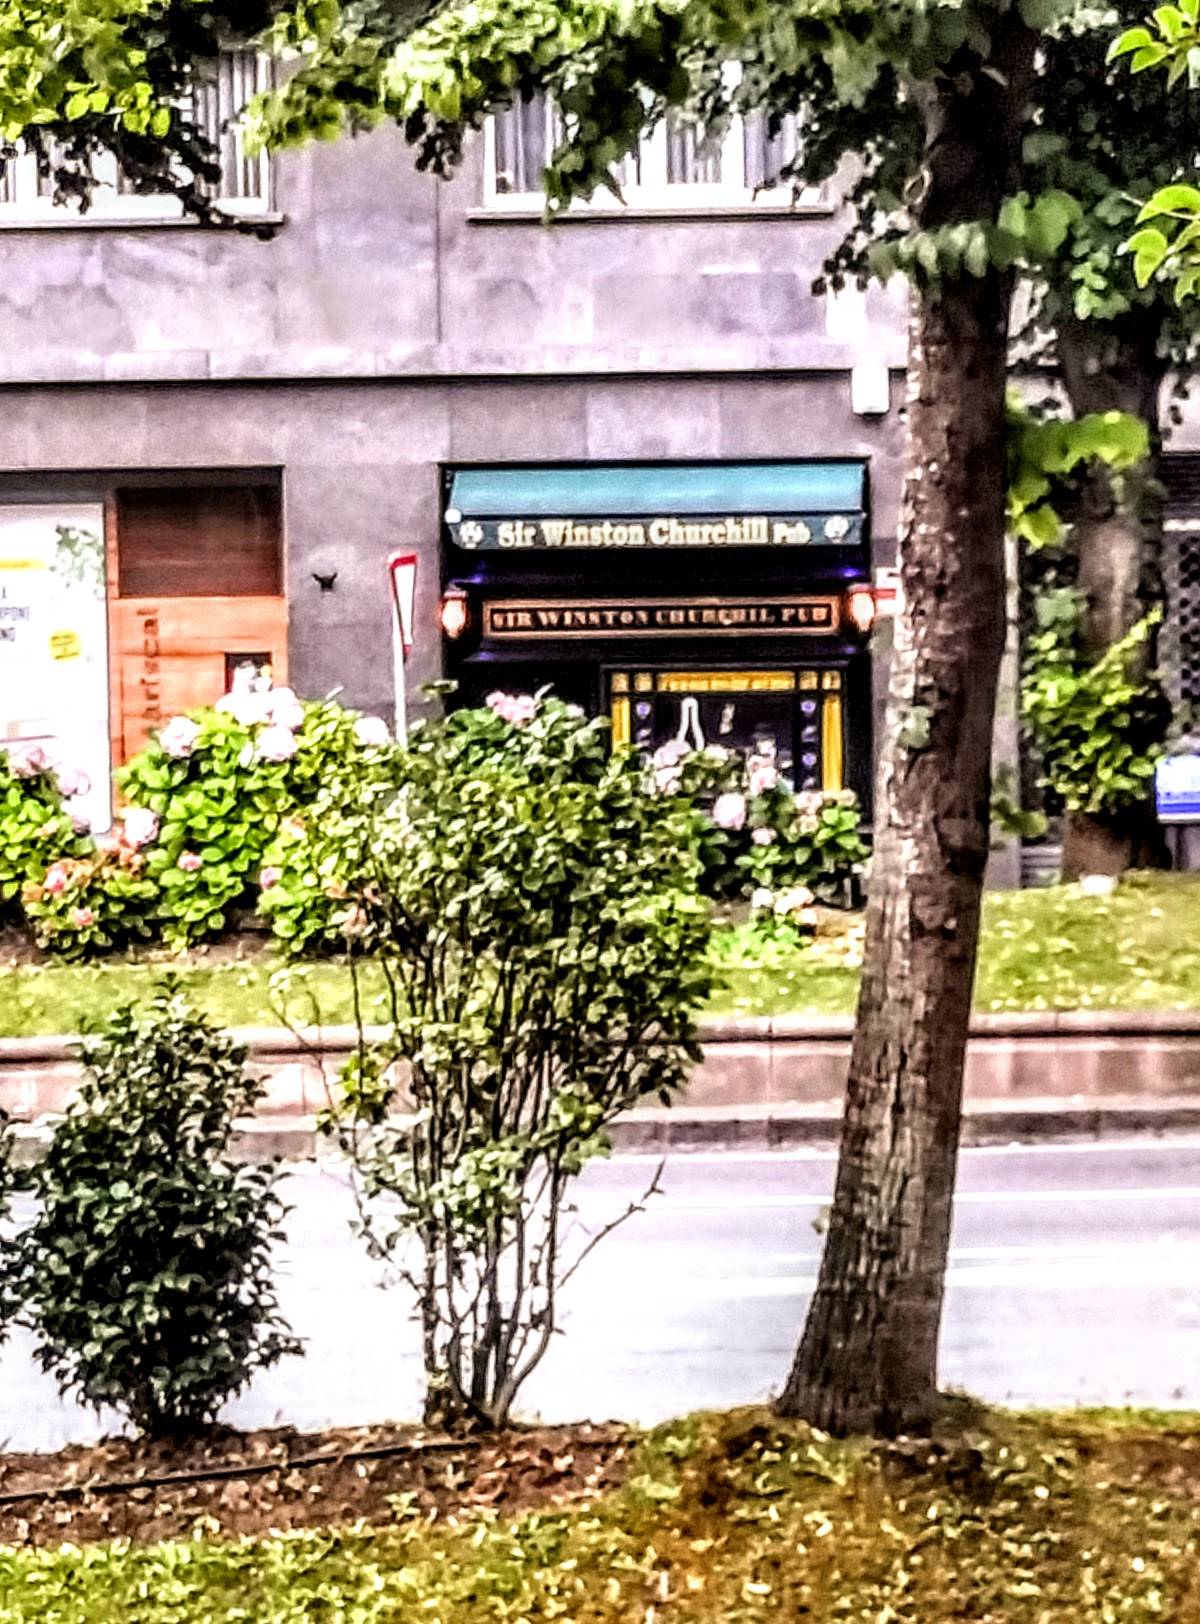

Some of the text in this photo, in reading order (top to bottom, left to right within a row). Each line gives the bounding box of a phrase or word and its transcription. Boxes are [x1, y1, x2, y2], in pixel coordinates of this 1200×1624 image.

[498, 516, 811, 547] Sir Winston Churchill Pub
[493, 612, 532, 629] SIR
[537, 610, 648, 627] WINSTON
[781, 607, 828, 625] PUB
